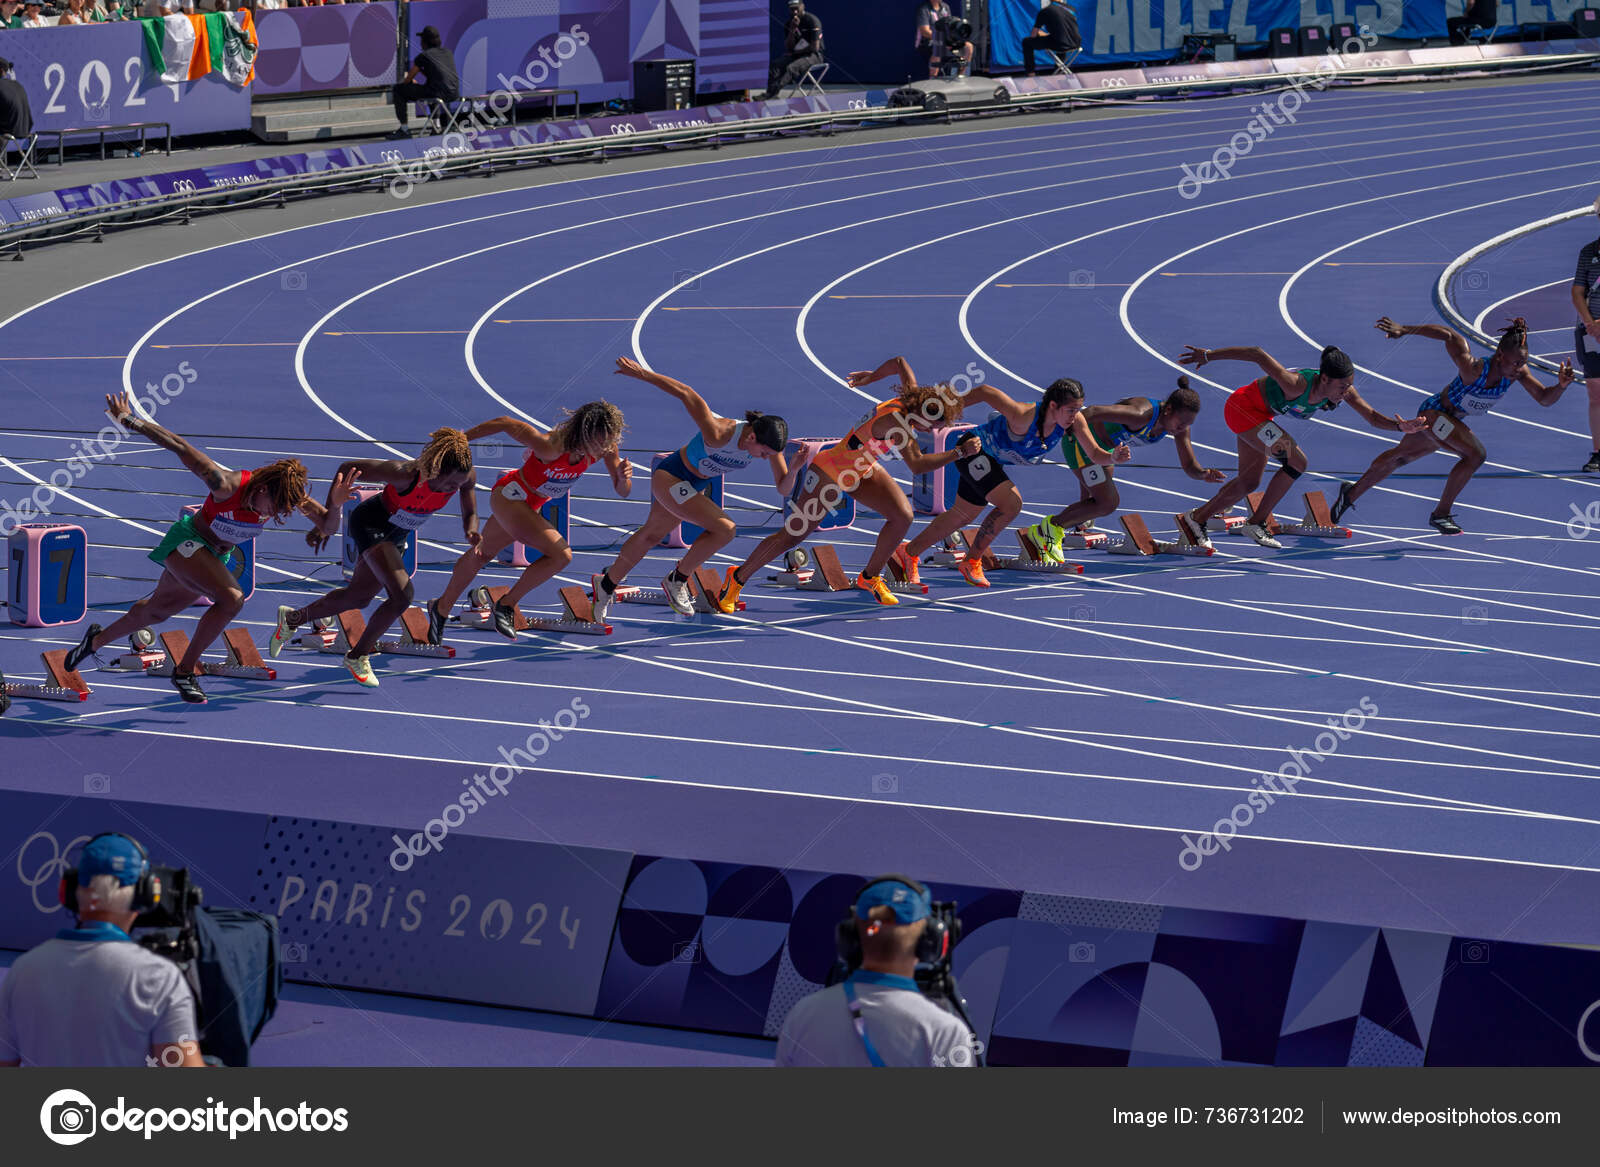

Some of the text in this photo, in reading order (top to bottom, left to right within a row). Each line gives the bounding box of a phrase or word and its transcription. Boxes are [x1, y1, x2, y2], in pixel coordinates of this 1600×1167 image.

[1265, 429, 1276, 439] 2
[974, 463, 985, 471] 4
[1089, 470, 1098, 480] 3
[680, 487, 689, 497] 6
[49, 548, 76, 605] 7
[443, 894, 581, 950] 2024
